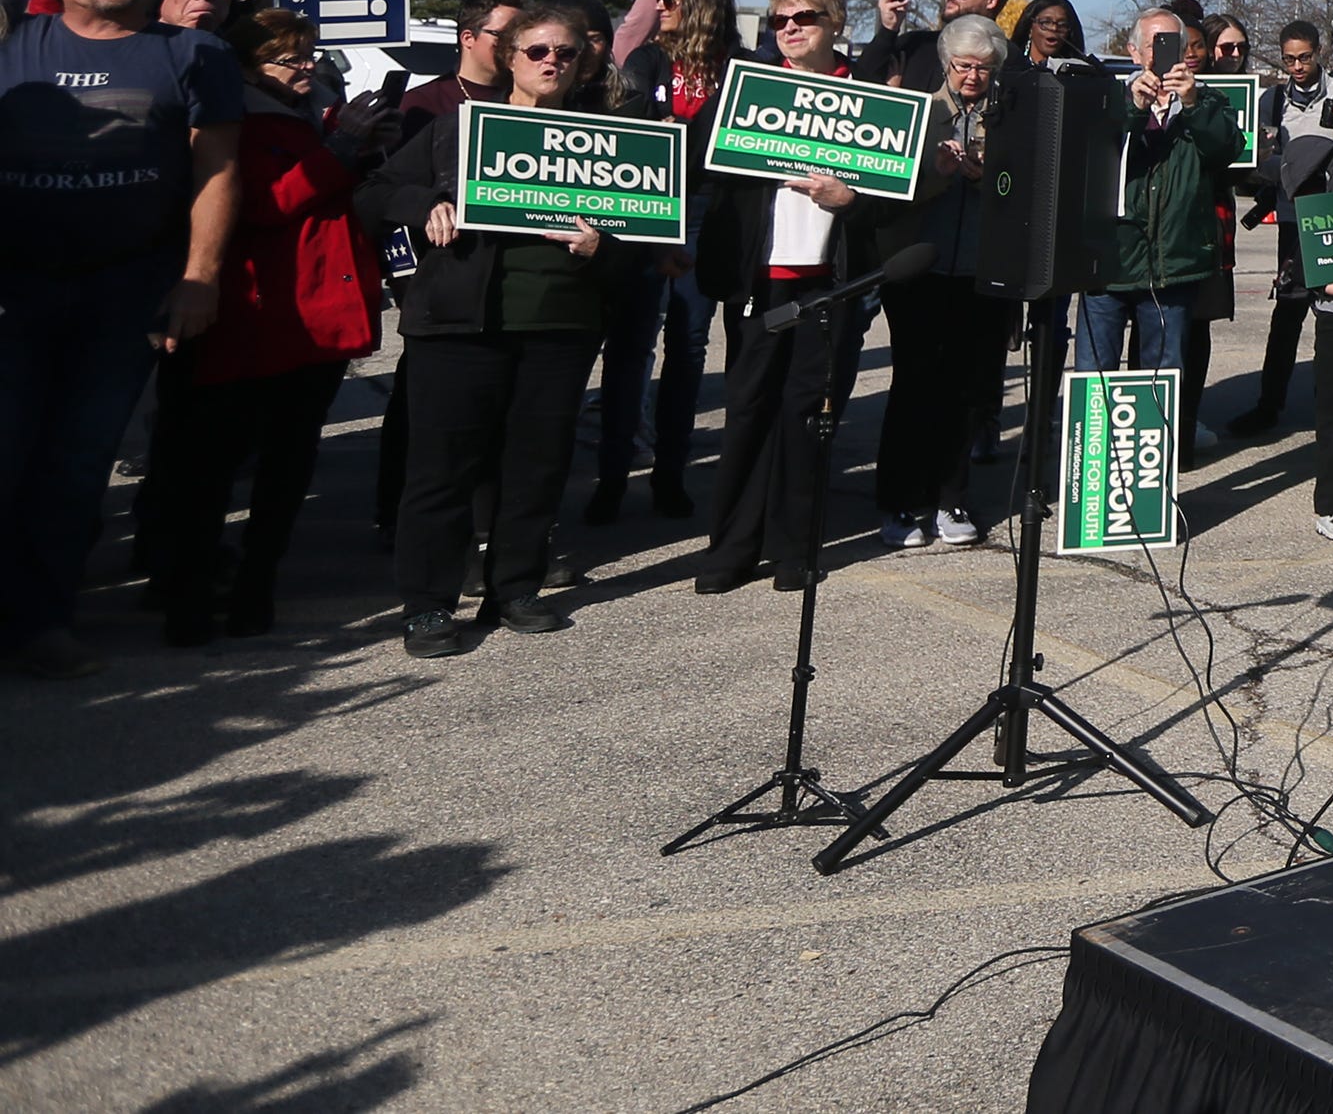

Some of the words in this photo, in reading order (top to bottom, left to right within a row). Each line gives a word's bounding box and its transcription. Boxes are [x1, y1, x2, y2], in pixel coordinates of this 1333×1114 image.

[56, 72, 109, 87] THE
[793, 87, 863, 118] RON
[543, 127, 617, 157] RON
[735, 104, 906, 153] JOHNSON
[483, 151, 666, 192] JOHNSON
[724, 133, 811, 157] FIGHTING
[815, 147, 853, 165] FOR
[855, 154, 906, 175] TRUTH
[475, 186, 571, 208] FIGHTING
[576, 195, 614, 211] FOR
[619, 198, 672, 216] TRUTH
[525, 212, 627, 228] www.Wisfcts.com
[1087, 383, 1105, 456] FIGHTING
[1071, 421, 1082, 504] www.Wisfacts.com
[1086, 460, 1102, 492] FOR
[1107, 387, 1137, 534] JOHNSON
[1138, 428, 1161, 489] RON
[1084, 495, 1100, 541] TRUTH
